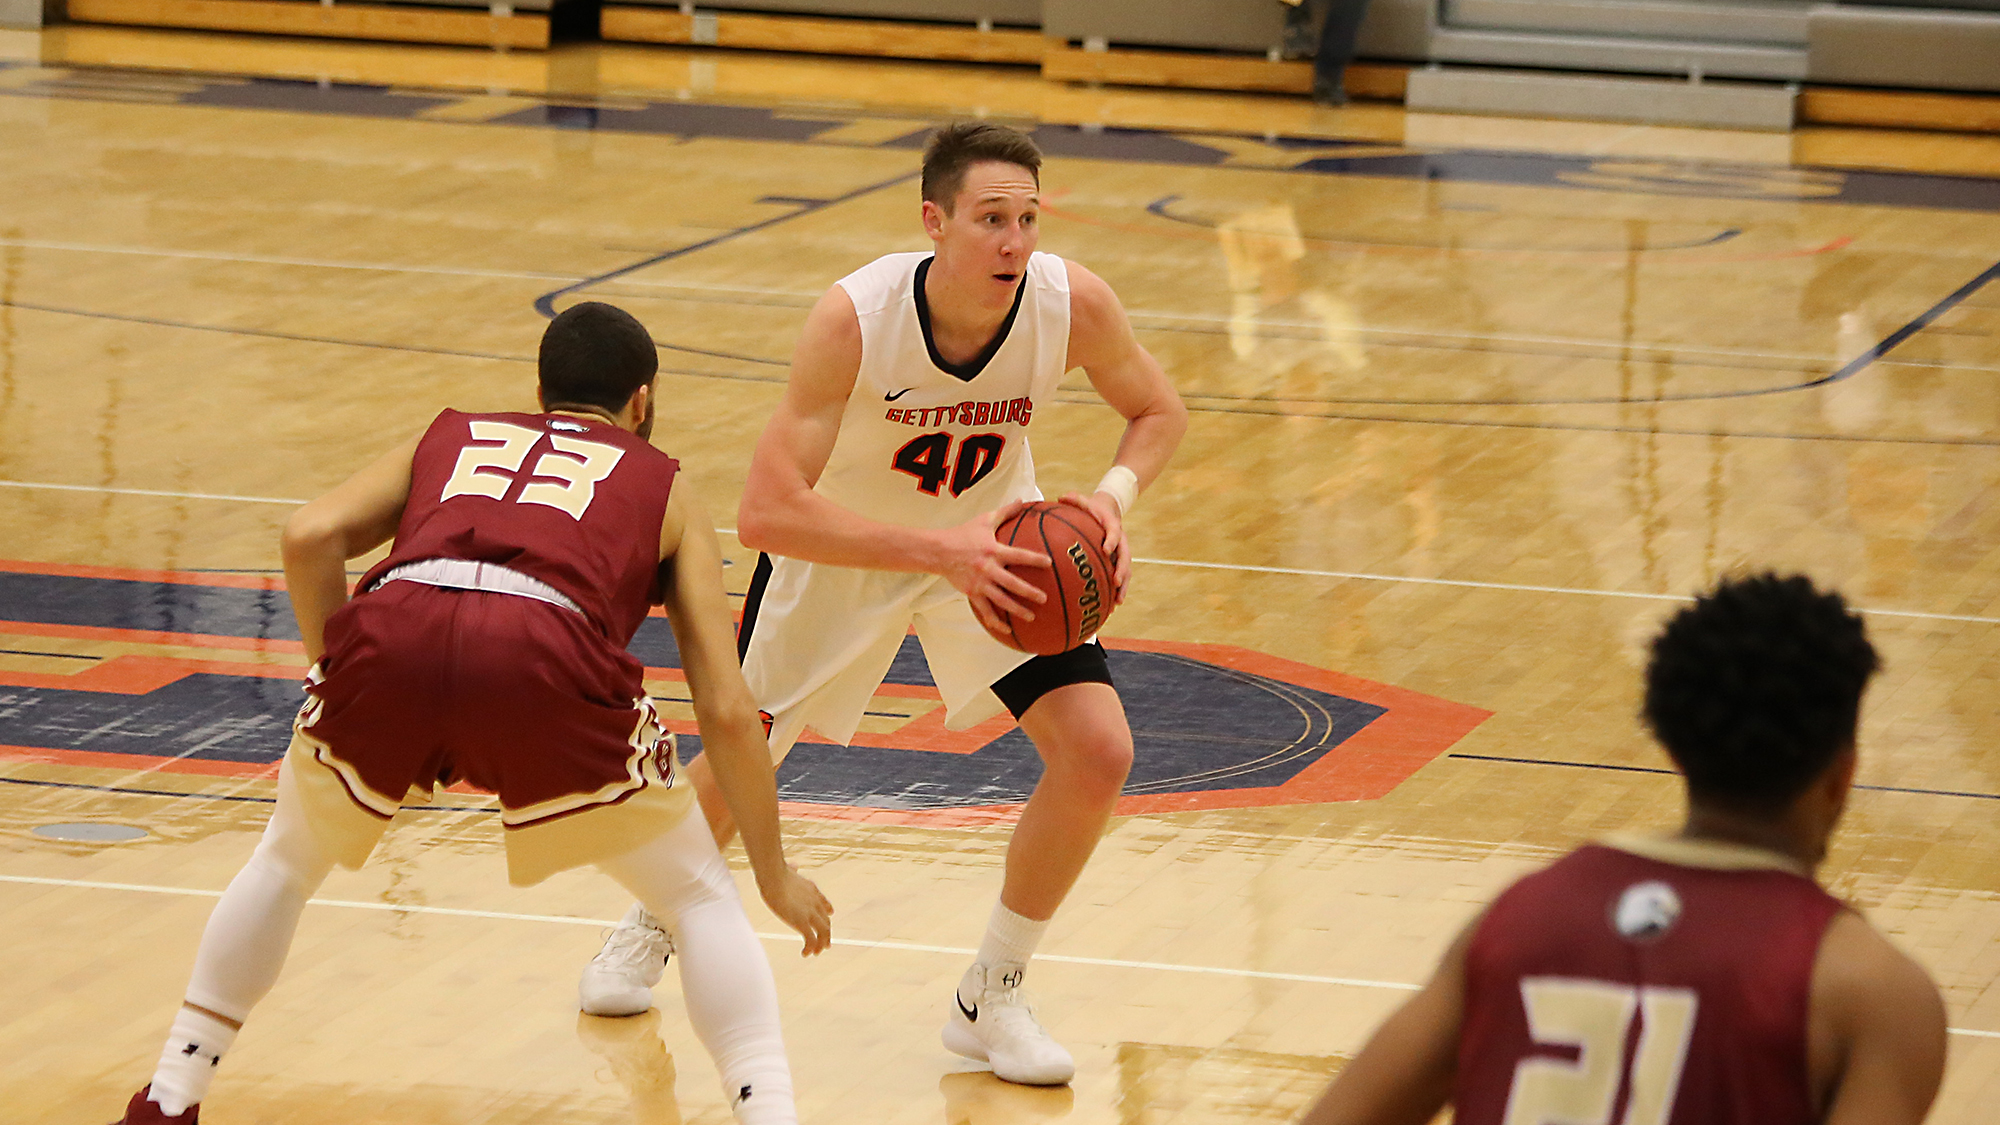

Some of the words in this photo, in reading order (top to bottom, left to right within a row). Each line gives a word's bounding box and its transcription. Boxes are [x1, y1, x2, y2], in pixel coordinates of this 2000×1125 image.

[885, 396, 1033, 427] GETTYSBURG
[440, 421, 626, 521] 23
[891, 431, 1006, 499] 40
[1067, 541, 1101, 641] Wilson
[1503, 976, 1699, 1125] 21
